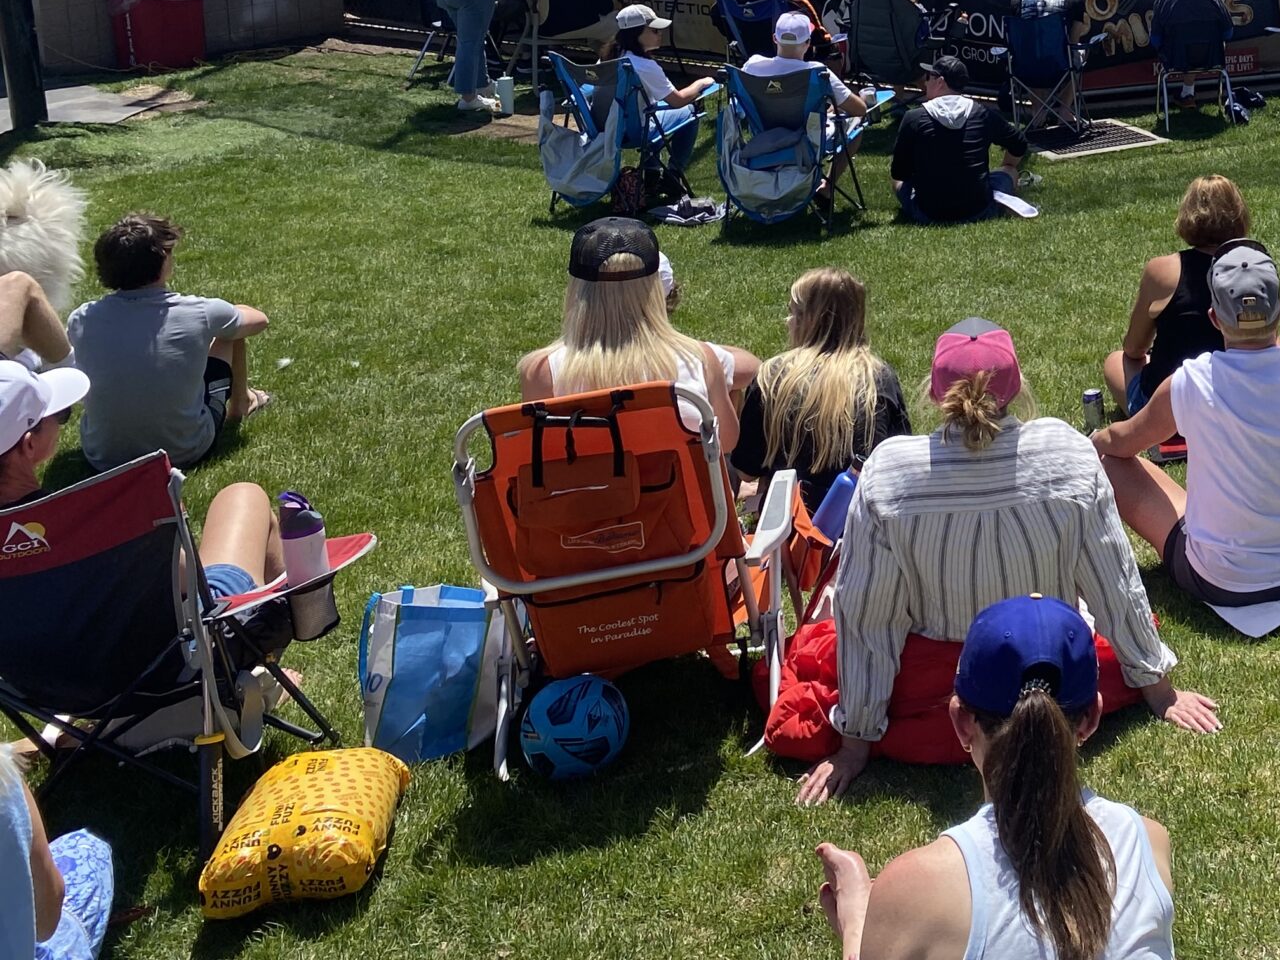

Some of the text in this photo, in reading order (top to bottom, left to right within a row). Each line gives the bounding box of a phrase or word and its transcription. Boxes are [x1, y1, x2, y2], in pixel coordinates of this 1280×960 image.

[2, 539, 40, 553] GCI
[577, 613, 659, 634] The Coolest Spot
[590, 627, 652, 644] in Paradise
[211, 880, 261, 900] FUZZY
[210, 891, 261, 909] FUNNY
